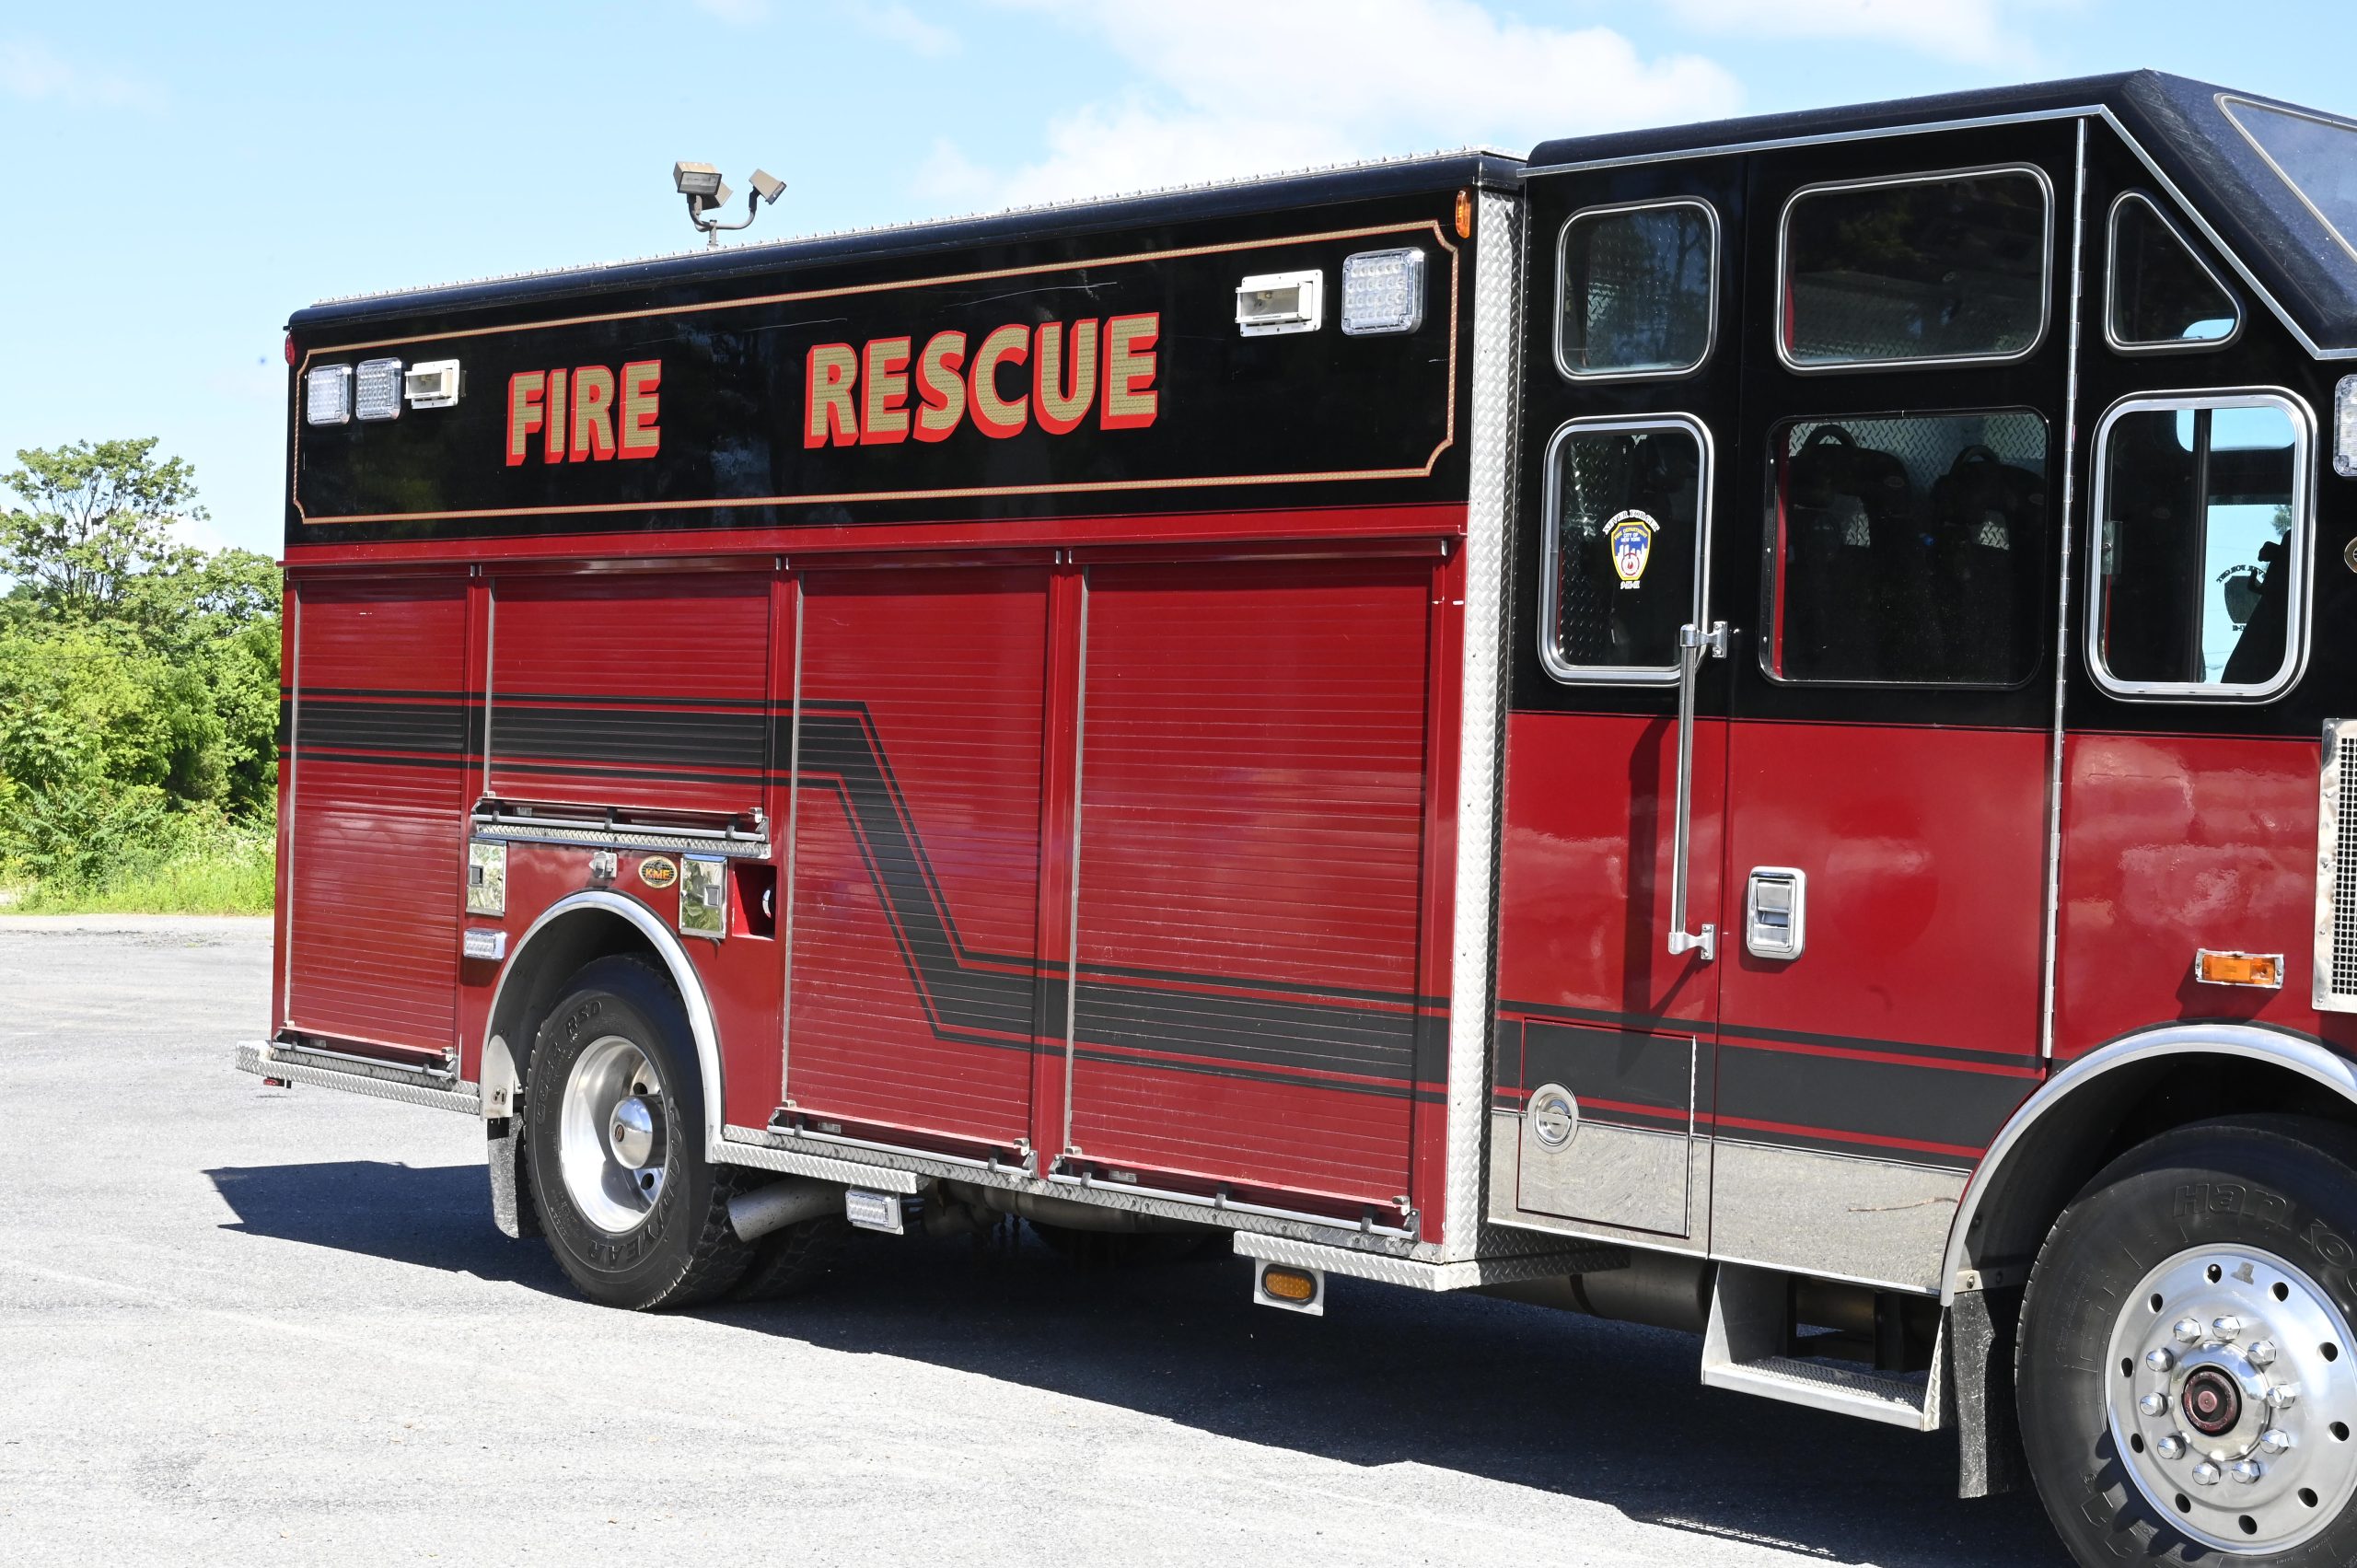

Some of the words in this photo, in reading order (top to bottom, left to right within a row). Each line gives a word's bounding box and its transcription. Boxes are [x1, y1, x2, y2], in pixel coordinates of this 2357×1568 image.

[506, 359, 661, 466] FIRE
[804, 311, 1159, 449] RESCUE
[645, 868, 671, 879] KME
